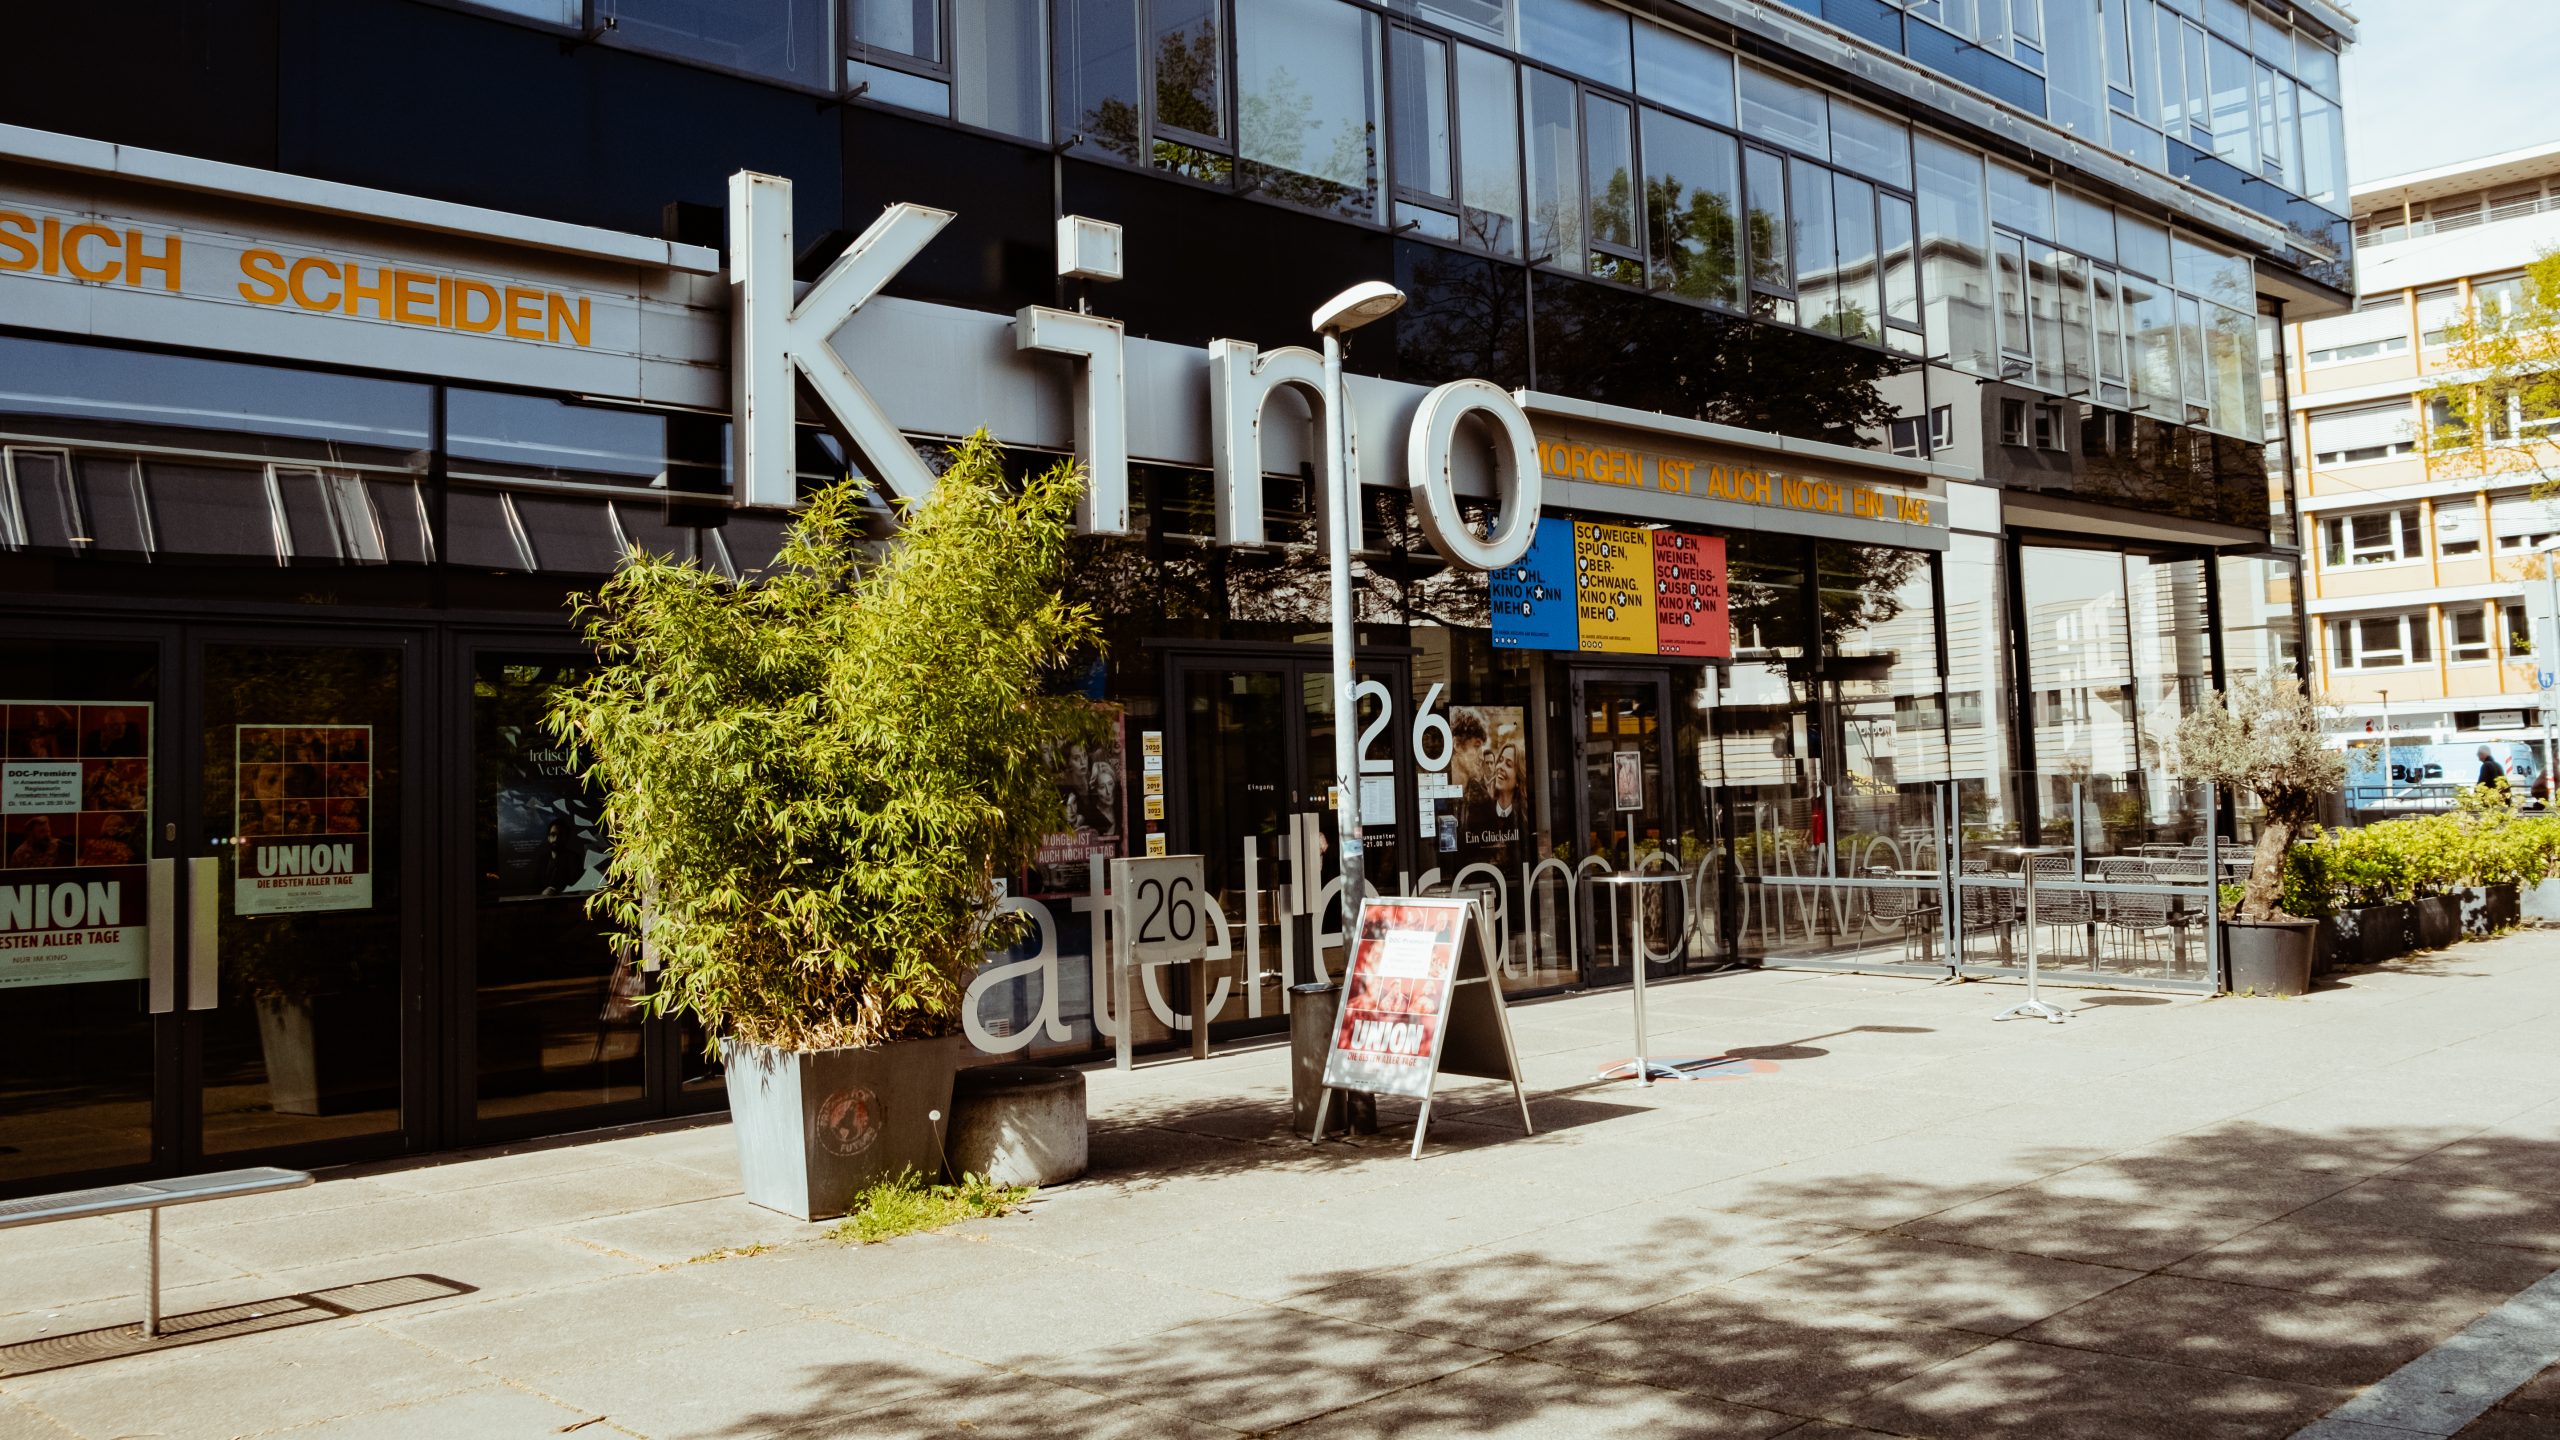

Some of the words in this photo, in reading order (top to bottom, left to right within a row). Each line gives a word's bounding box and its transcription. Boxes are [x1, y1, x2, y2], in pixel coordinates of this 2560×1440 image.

[0, 210, 182, 292] SICH
[237, 246, 591, 347] SCHEIDEN
[728, 168, 1542, 573] Kino
[1657, 456, 1695, 494] IST
[1708, 466, 1771, 506] AUCH
[1781, 475, 1843, 514] NOCH
[1853, 487, 1884, 518] EIN
[1892, 494, 1929, 525] TAG
[1656, 550, 1699, 567] WEINEN,
[1492, 583, 1523, 599] KINO
[1580, 589, 1607, 604] KINO
[1493, 600, 1536, 617] MEHR.
[1658, 596, 1684, 610] KINO
[1580, 605, 1619, 622] MEHR.
[1659, 611, 1696, 627] MEHR.
[1356, 680, 1453, 772] 26
[1465, 832, 1480, 844] Ein
[1481, 829, 1520, 843] Glücksfall
[257, 843, 353, 877] UNION
[1039, 848, 1060, 864] AUCH
[257, 880, 270, 888] DIE
[273, 877, 304, 888] BESTEN
[306, 876, 331, 886] ALLER
[333, 876, 353, 885] TAGE
[1138, 877, 1196, 944] 26
[42, 932, 83, 947] ALLER
[87, 930, 120, 944] TAGE
[1350, 1019, 1425, 1055] UNION
